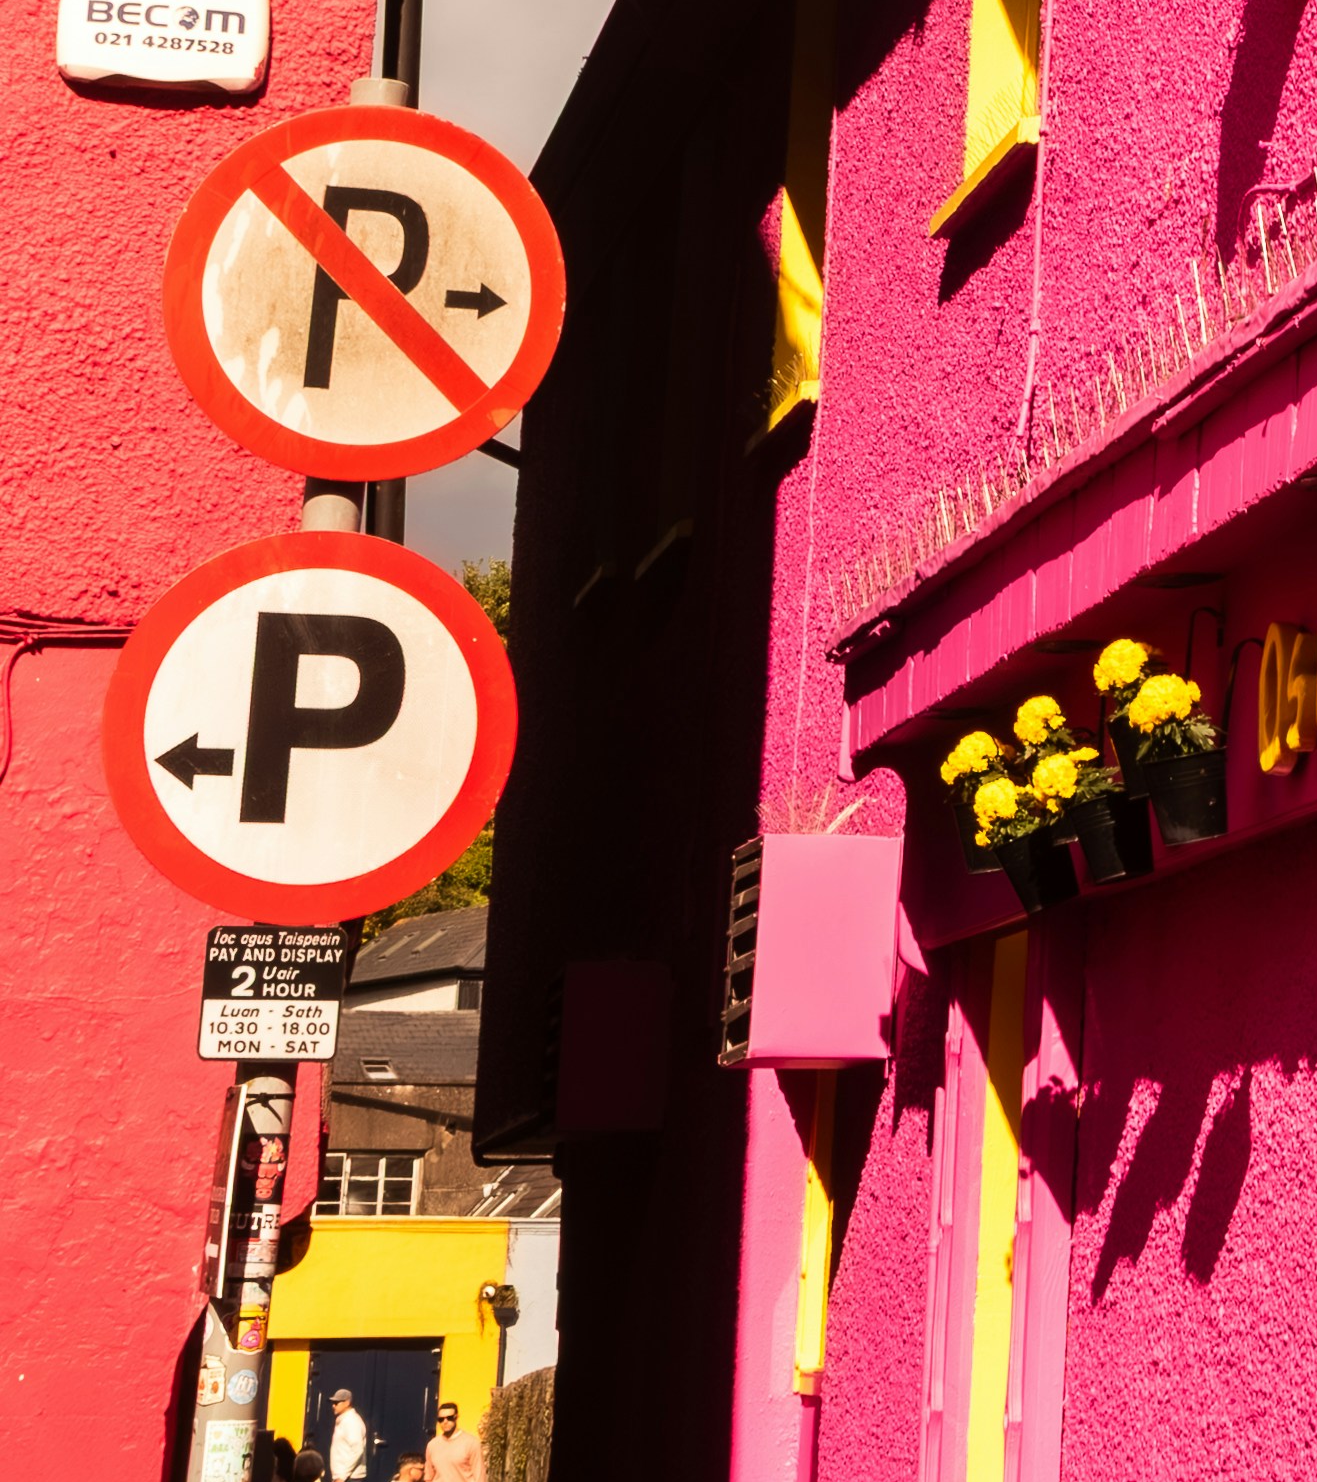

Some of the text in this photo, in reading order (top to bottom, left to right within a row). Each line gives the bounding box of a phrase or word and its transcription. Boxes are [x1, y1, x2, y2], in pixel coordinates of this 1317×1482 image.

[94, 32, 235, 55] 021 4287528
[303, 185, 430, 389] P
[239, 611, 406, 824] P
[240, 934, 273, 947] agus
[209, 948, 343, 963] PAY AND DISPLAY
[230, 965, 300, 997] 2 Uair
[262, 983, 316, 998] HOUR
[220, 1004, 260, 1018] Luan
[282, 1004, 323, 1018] Sath
[209, 1021, 258, 1035] 10.30
[282, 1022, 330, 1035] 18.00
[217, 1040, 261, 1053] MON
[285, 1040, 320, 1053] SAT
